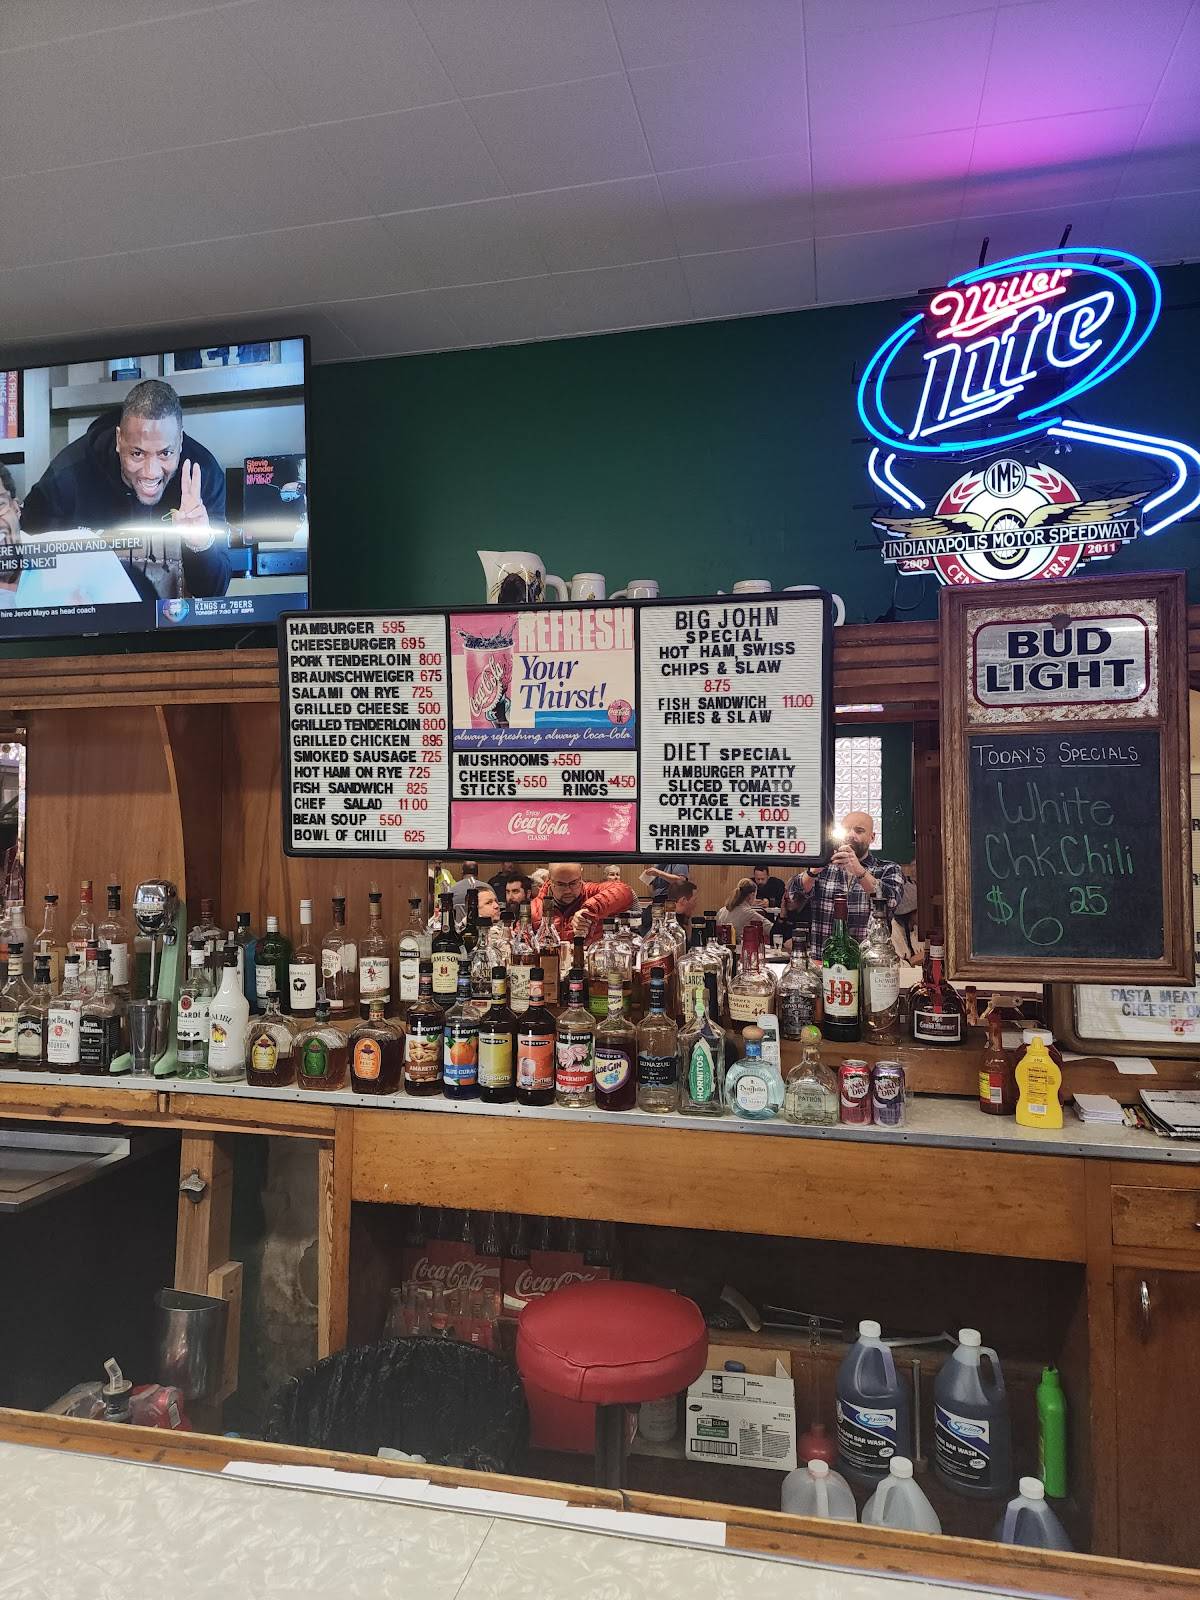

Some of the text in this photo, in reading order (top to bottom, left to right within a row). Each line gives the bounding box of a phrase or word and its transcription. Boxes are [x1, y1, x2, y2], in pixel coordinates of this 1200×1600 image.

[930, 269, 1072, 328] Miller
[908, 291, 1114, 440] Lite
[990, 462, 1021, 492] IMS
[889, 522, 1129, 557] INDIANAPOLIS MOTOR SPEEDWAY
[15, 544, 40, 555] WITH
[43, 542, 82, 554] JORDAN
[86, 540, 106, 551] AND
[903, 543, 1116, 569] 2009 2011
[20, 558, 56, 568] IS NEXT
[195, 602, 218, 610] KINGS
[676, 607, 778, 630] BIG JOHN
[290, 622, 405, 635] HAMBURGER 595
[519, 608, 633, 650] REFRESH
[686, 629, 762, 644] SPECIAL
[291, 637, 425, 650] CHEESEBURGER 695
[1008, 628, 1111, 659] BUD
[660, 646, 689, 659] HOT
[743, 642, 795, 656] SWISS
[291, 654, 441, 666] PORK TENDERLOIN 800
[520, 656, 578, 680] Your
[661, 660, 781, 676] CHIPS & SLAW
[292, 670, 442, 683] BRAUNSCHWEIGER 675
[986, 659, 1134, 692] LIGHT
[704, 679, 730, 692] 8.75
[292, 686, 432, 699] SALAMI ON RYE 725
[520, 681, 607, 709] Thirst!
[295, 703, 440, 714] GRILLED CHEESE 500
[659, 698, 689, 710] FISH
[698, 696, 766, 709] SANDWICH
[665, 710, 771, 724] FRIES & SLAW
[291, 719, 445, 730] GRILLED TENDERLOIN 800
[294, 735, 443, 746] GRILLED CHICKEN 895
[454, 731, 487, 747] always
[545, 730, 581, 746] always
[294, 751, 442, 762] SMOKED SAUSAGE 725
[664, 743, 791, 761] DIET SPECIAL
[1058, 742, 1138, 762] SPECIALS
[459, 754, 581, 766] MUSHROOMS 550
[295, 767, 430, 778] HOT HAM ON RYE 725
[663, 765, 795, 778] HAMBURGER PATTY
[459, 771, 547, 787] CHEESE 550
[562, 770, 635, 787] ONION 450
[293, 782, 427, 794] FISH SANDWICH 825
[461, 784, 516, 795] STICKS
[563, 784, 608, 796] RINGS
[669, 780, 792, 792] SLICED TOMATO
[295, 798, 325, 809] CHEF
[344, 798, 382, 809] SALAD
[659, 794, 800, 807] COTTAGE CHEESE
[998, 781, 1114, 826] White
[293, 814, 402, 826] BEAN SOUP 550
[678, 808, 733, 820] PICKLE
[294, 830, 424, 842] BOWL OF CHILI 625
[649, 824, 797, 839] SHRIMP PLATTER
[656, 839, 701, 851] FRIES
[705, 839, 713, 852] &
[722, 840, 767, 852] SLAW
[1060, 834, 1134, 876] Chili
[826, 980, 853, 1006] J&B
[958, 1448, 977, 1457] WASH
